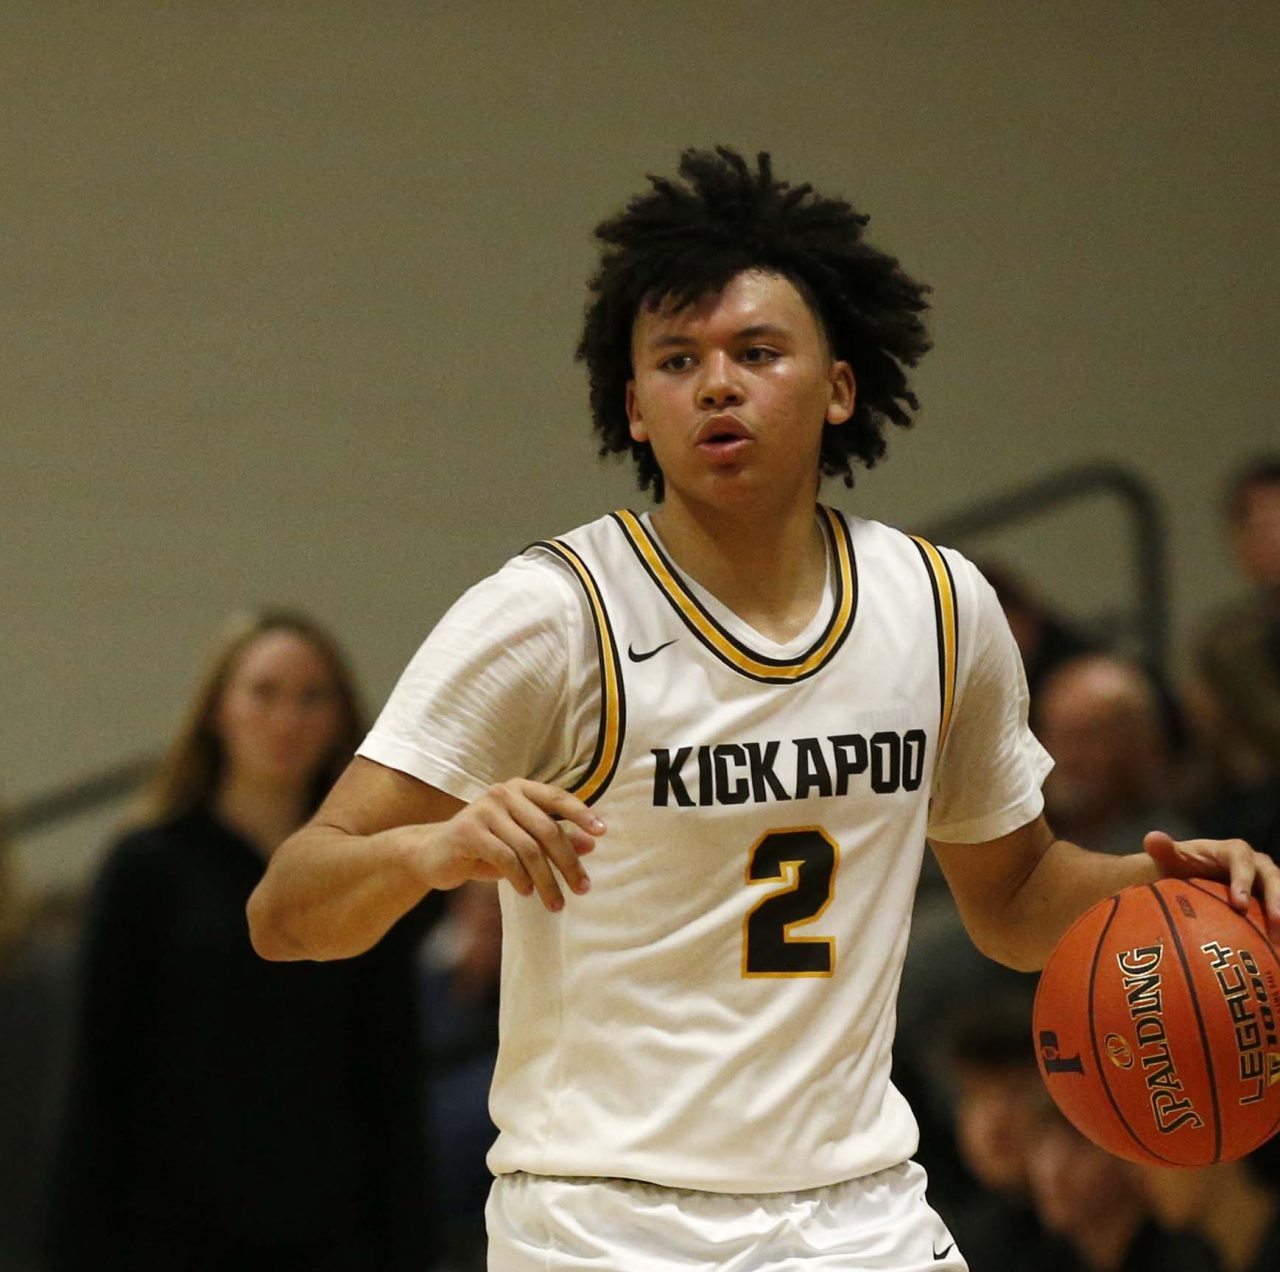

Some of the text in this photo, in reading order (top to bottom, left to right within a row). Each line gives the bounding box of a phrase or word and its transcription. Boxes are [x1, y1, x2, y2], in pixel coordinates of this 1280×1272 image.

[651, 729, 927, 807] KICKAPOO
[741, 825, 840, 979] 2
[1116, 943, 1205, 1135] SPALDING
[1200, 940, 1265, 1107] LEGACY
[1237, 949, 1279, 1047] 1000
